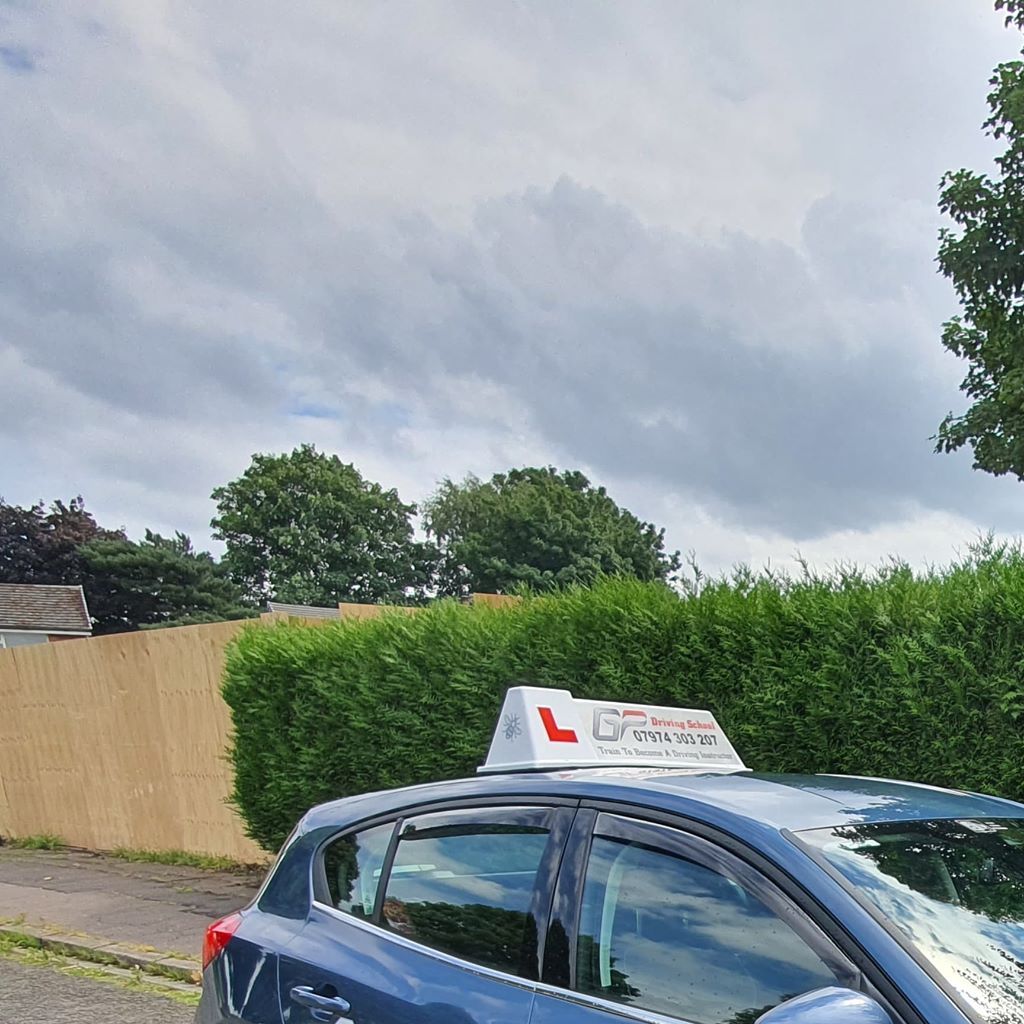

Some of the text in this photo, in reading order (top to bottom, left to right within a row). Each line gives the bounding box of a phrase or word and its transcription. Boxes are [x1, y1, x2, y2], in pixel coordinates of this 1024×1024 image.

[537, 706, 579, 743] L
[592, 707, 647, 742] GP
[651, 716, 716, 730] Driving School
[632, 729, 719, 746] 07974 303 207
[597, 745, 621, 756] Train
[621, 746, 633, 757] To
[634, 747, 664, 758] Become
[664, 748, 673, 757] A
[673, 749, 700, 760] Driving
